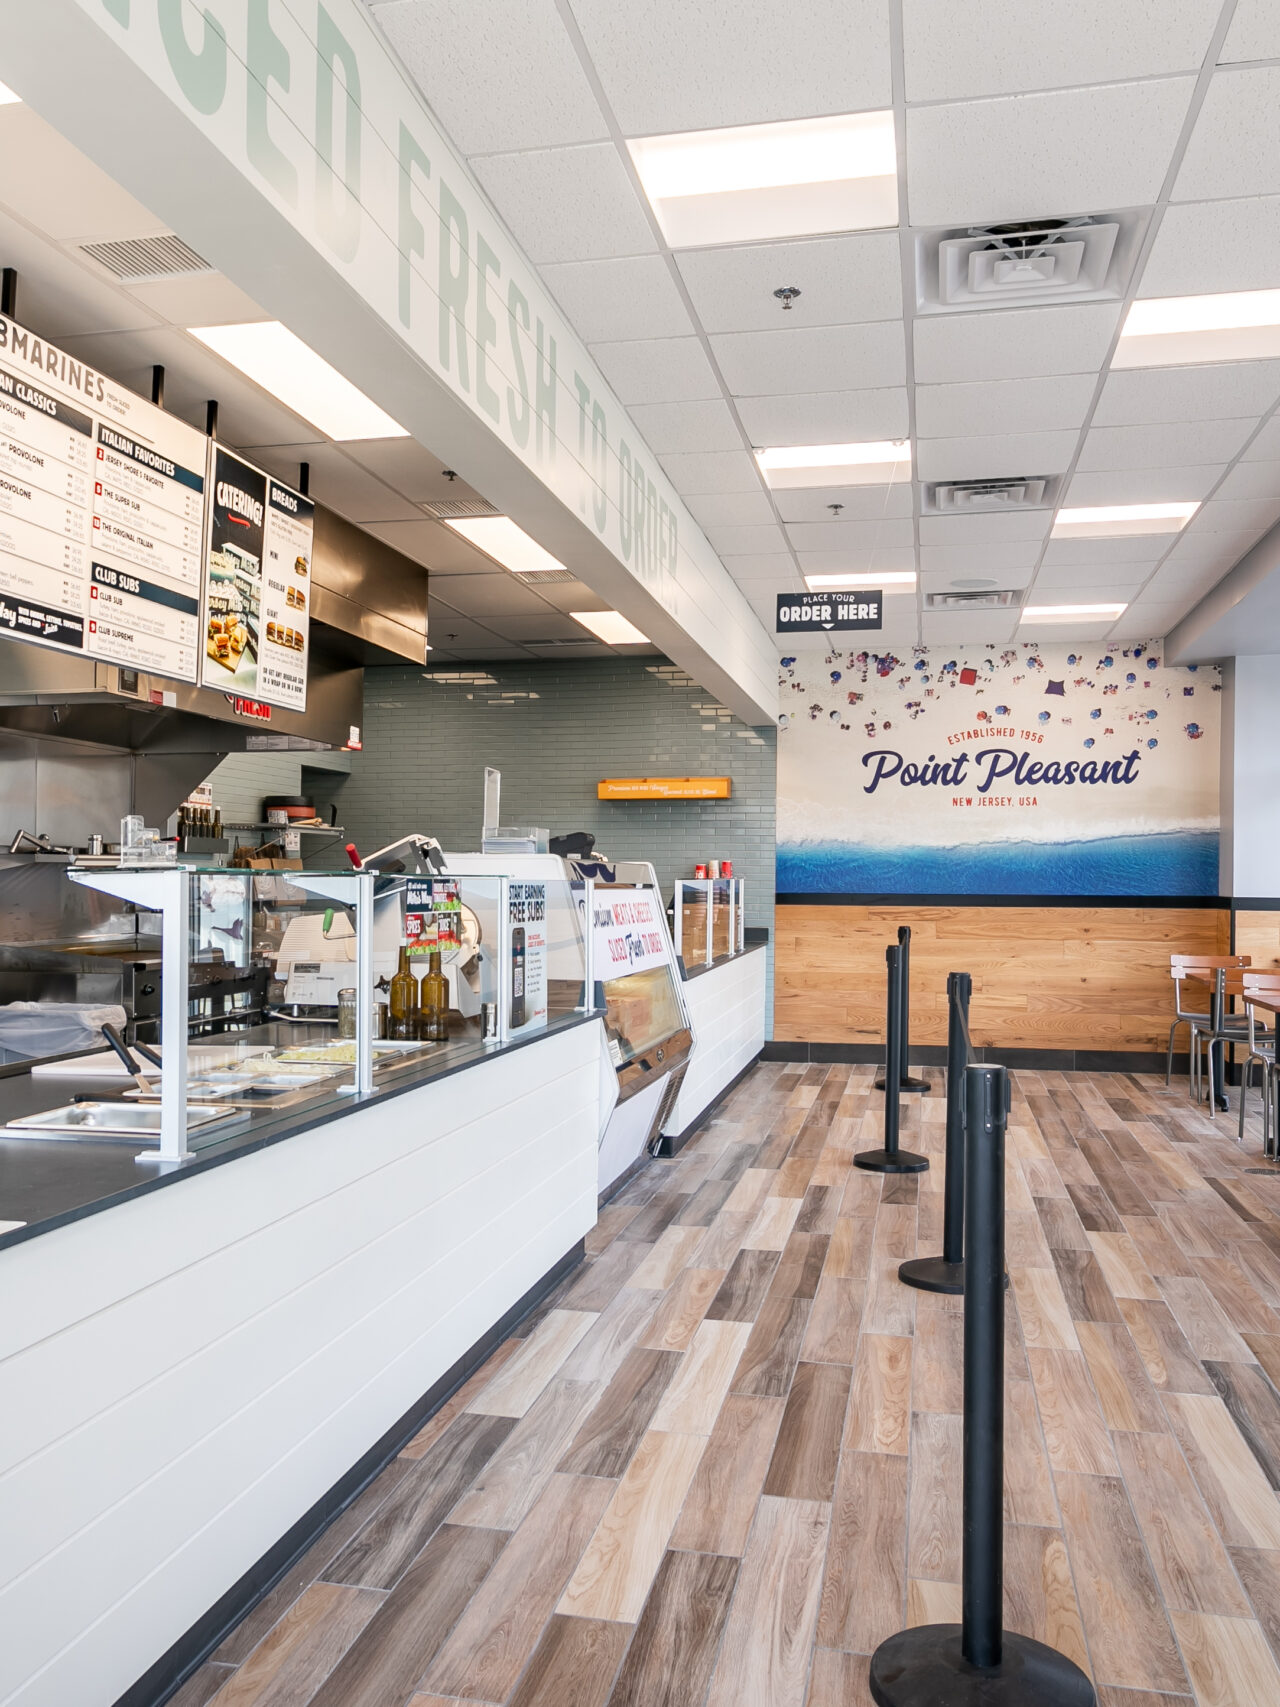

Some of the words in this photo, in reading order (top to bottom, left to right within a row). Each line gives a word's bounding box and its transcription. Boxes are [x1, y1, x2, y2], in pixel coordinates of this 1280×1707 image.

[398, 116, 557, 468] FRESH
[573, 369, 607, 534] TO
[620, 437, 678, 582] ORDER
[16, 383, 57, 416] CLASSICS
[9, 444, 44, 467] PROVOLONE
[101, 428, 133, 456] ITALIAN
[135, 442, 175, 477] FAVORITES
[105, 455, 122, 467] JERSEY
[143, 473, 164, 489] FAVORITE
[104, 488, 113, 499] THE
[115, 494, 130, 506] SUPER
[131, 501, 140, 511] SUB
[217, 481, 263, 527] CATERING!
[272, 486, 298, 513] BREADS
[102, 522, 112, 533] THE
[113, 527, 135, 542] ORIGINAL
[95, 566, 117, 586] CLUB
[118, 575, 140, 593] SUBS
[269, 578, 285, 594] REGULAR
[803, 594, 829, 604] PLACE
[831, 593, 855, 603] YOUR
[780, 604, 832, 623] ORDER
[837, 603, 878, 621] HERE
[948, 727, 1015, 746] ESTABLISHED
[1020, 729, 1045, 744] 1956
[862, 749, 968, 794] Point
[975, 748, 1142, 793] Pleasant
[952, 797, 972, 807] NEW
[977, 796, 1014, 808] JERSEY,
[1019, 796, 1038, 806] USA
[509, 885, 523, 900] START
[525, 885, 544, 899] EARNING
[509, 901, 525, 923] FREE
[527, 901, 544, 922] SUBS!
